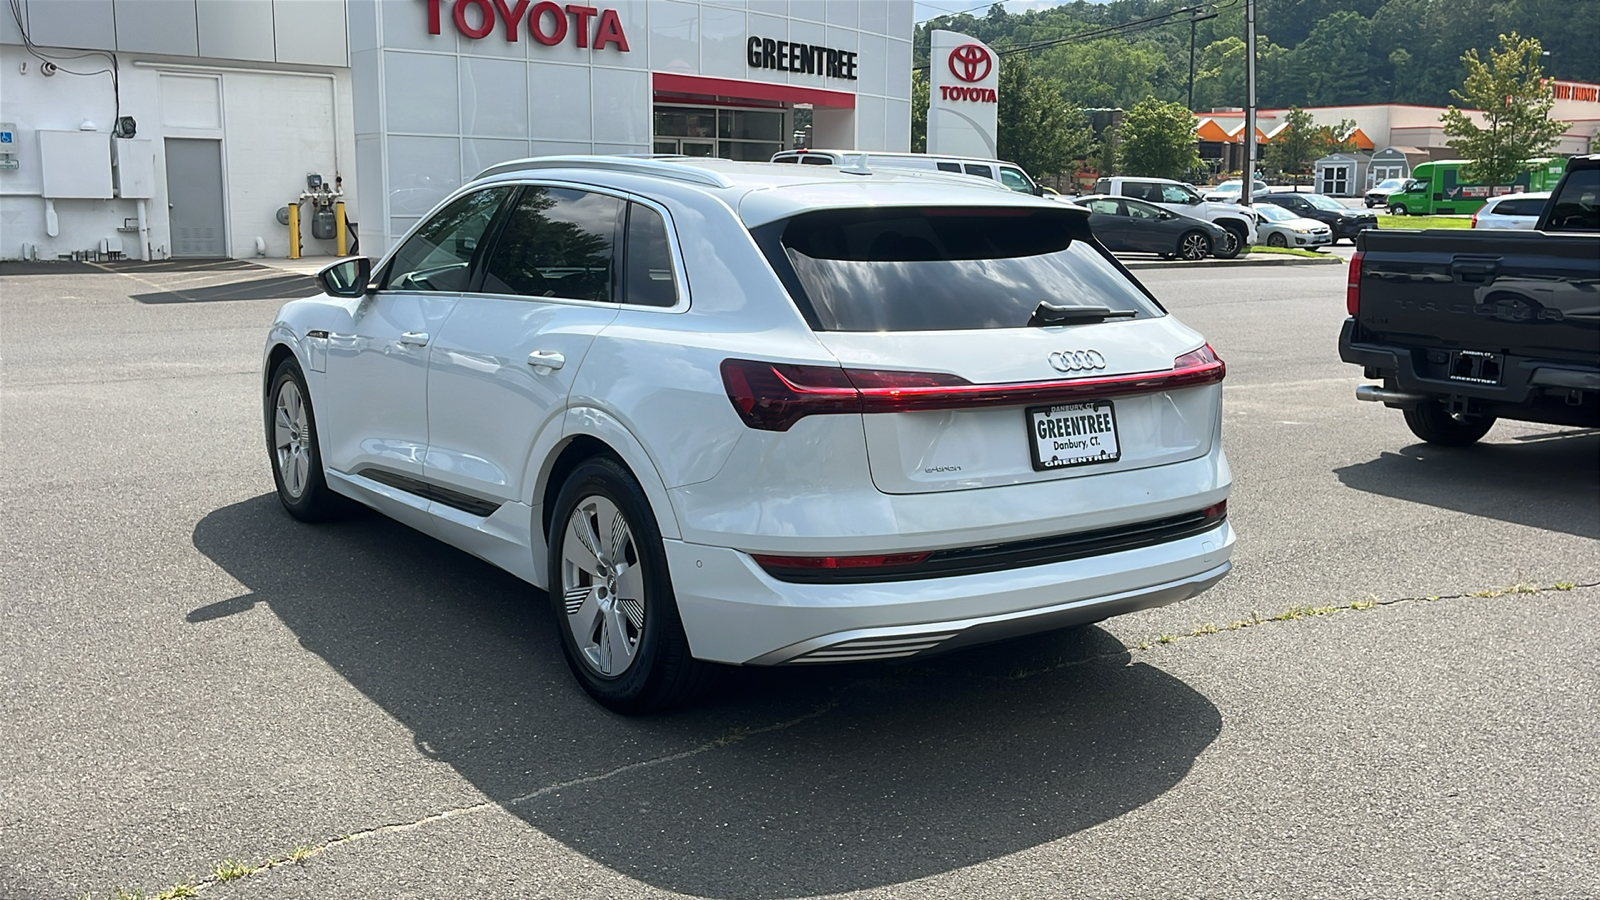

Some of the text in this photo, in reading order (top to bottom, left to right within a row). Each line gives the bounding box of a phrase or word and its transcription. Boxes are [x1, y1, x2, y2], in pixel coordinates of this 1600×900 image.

[426, 0, 630, 52] TOYOTA
[747, 36, 858, 80] GREENTREE
[940, 86, 997, 103] TOYOTA
[1554, 84, 1598, 102] THE HOME
[1450, 375, 1497, 384] GREENTREE
[1037, 413, 1111, 440] GREENTREE
[1053, 436, 1101, 451] Danbury, CT.
[1044, 453, 1118, 467] GREENTREE
